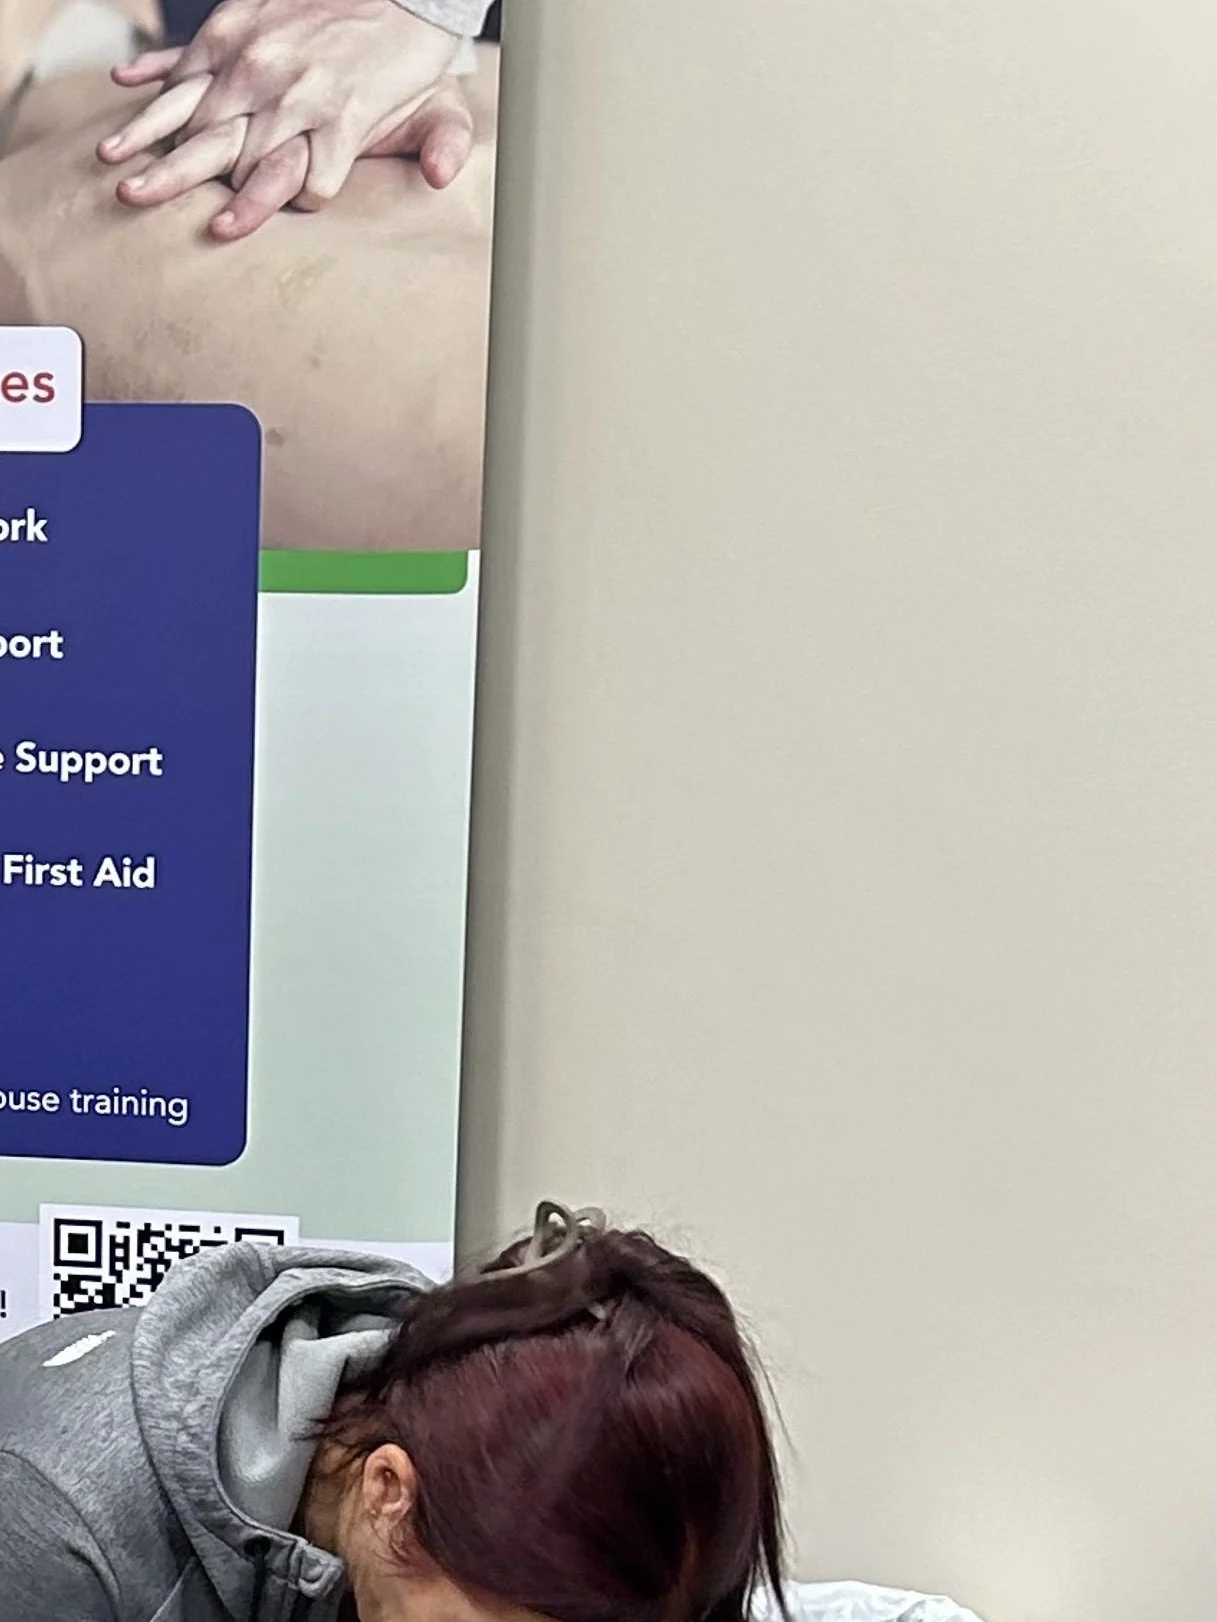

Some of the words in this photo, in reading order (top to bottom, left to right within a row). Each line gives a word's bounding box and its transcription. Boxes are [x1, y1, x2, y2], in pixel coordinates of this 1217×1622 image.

[15, 741, 163, 783] Support
[3, 854, 83, 887] First
[92, 856, 155, 889] Aid
[69, 1087, 188, 1126] training
